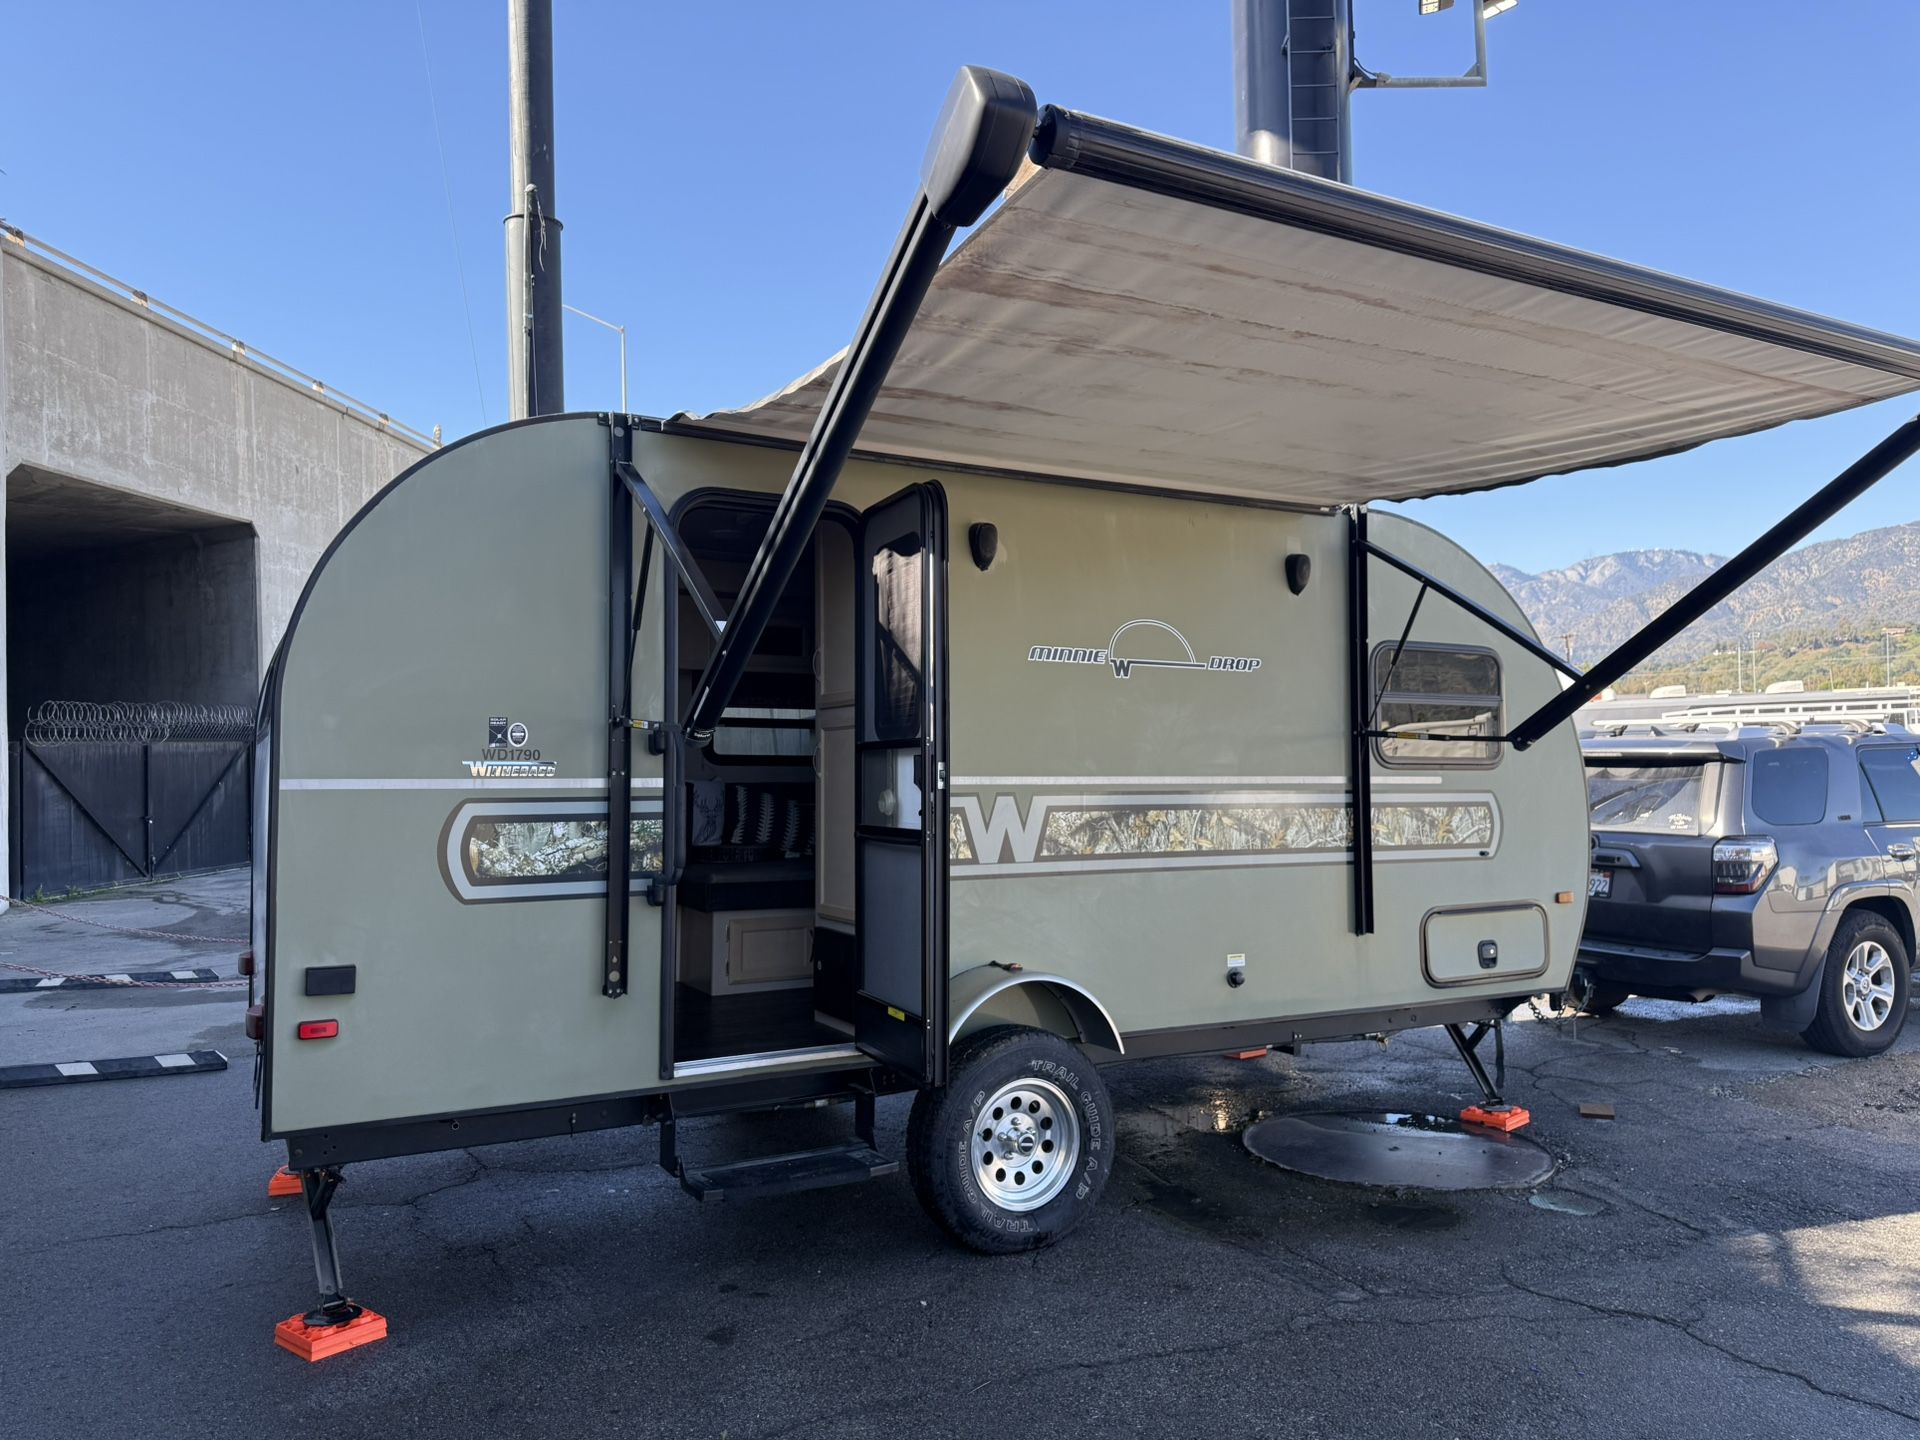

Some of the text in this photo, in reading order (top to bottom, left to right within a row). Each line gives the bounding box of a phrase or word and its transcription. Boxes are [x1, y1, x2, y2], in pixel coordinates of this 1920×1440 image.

[1028, 646, 1107, 664] MINNIE
[1208, 656, 1261, 672] DROP
[481, 749, 541, 761] WD1790
[462, 760, 557, 777] WINNEBAGO
[1031, 1059, 1083, 1090] TRAIL
[1080, 1090, 1101, 1150] GUIDE
